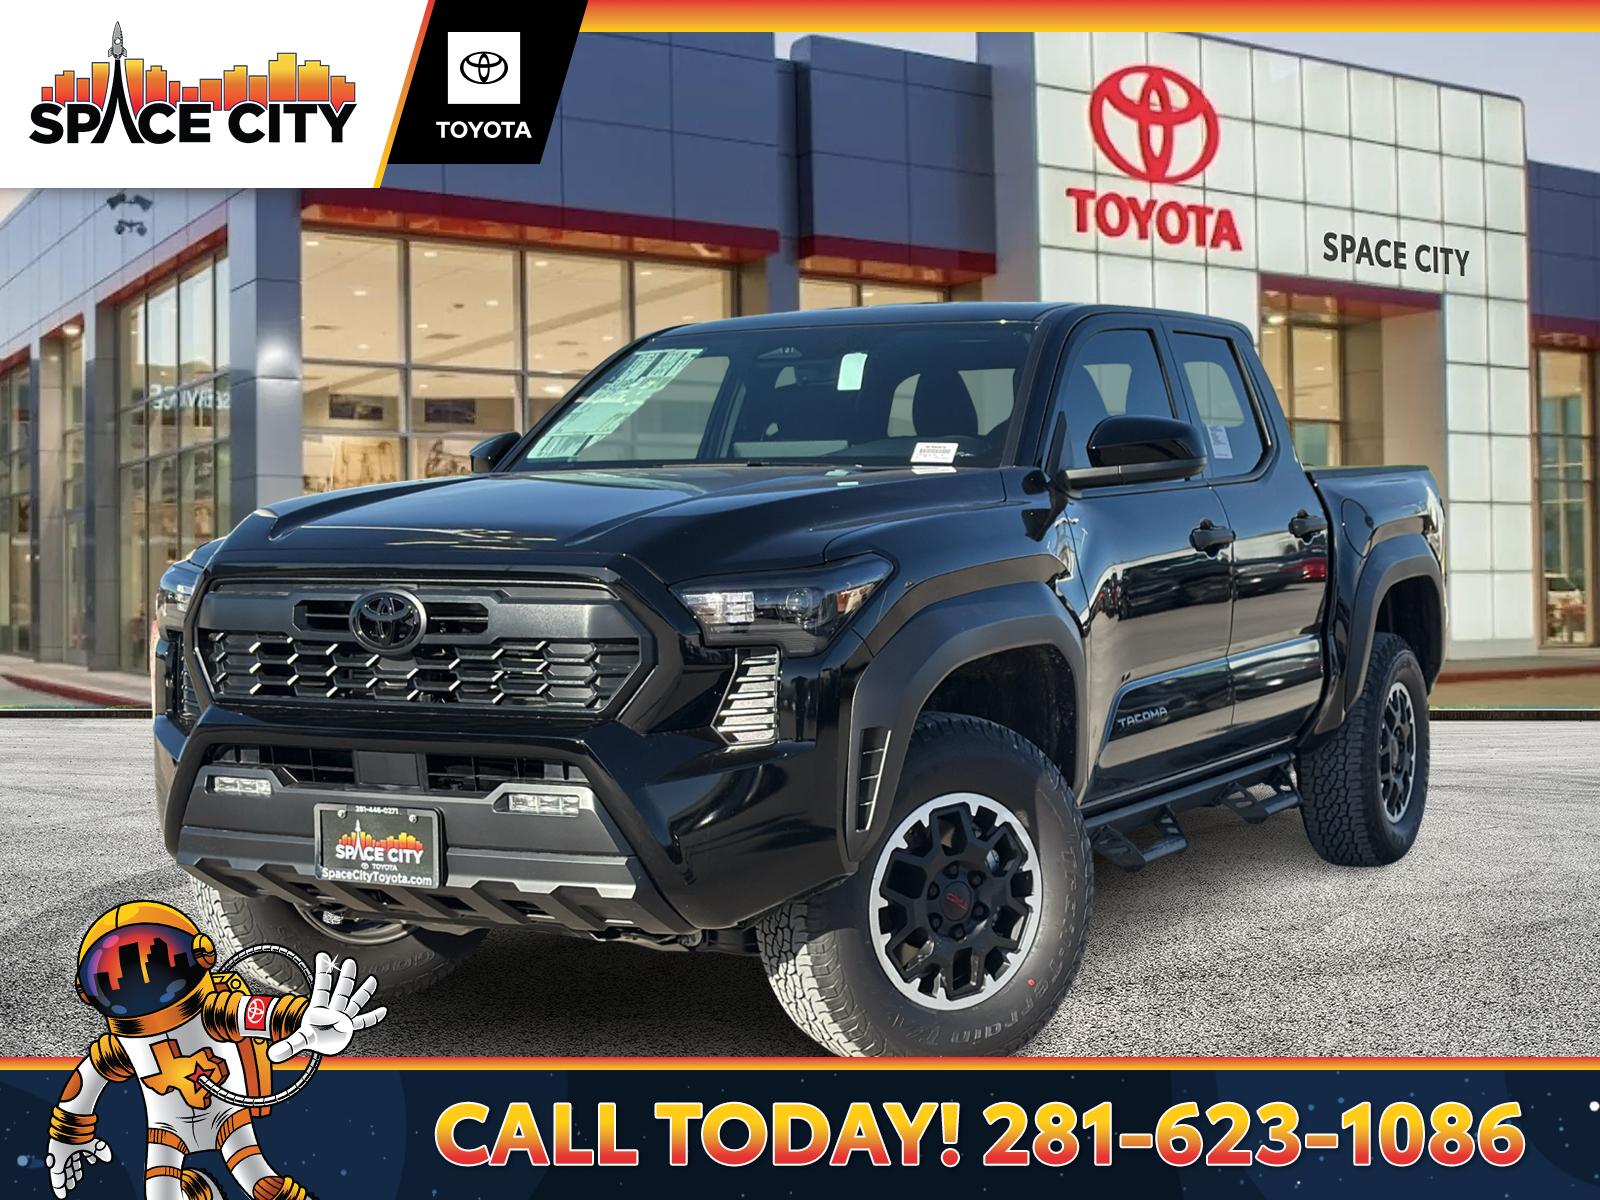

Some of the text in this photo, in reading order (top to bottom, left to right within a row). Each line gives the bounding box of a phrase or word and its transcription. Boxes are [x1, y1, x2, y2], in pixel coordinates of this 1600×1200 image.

[1066, 187, 1243, 251] TOYOTA
[1323, 232, 1470, 277] SPACE CITY
[1117, 706, 1168, 727] TACOMA
[335, 844, 424, 864] SPACE CITY
[322, 867, 432, 886] SpaceCityToyota.com
[372, 863, 398, 871] TOYOTA
